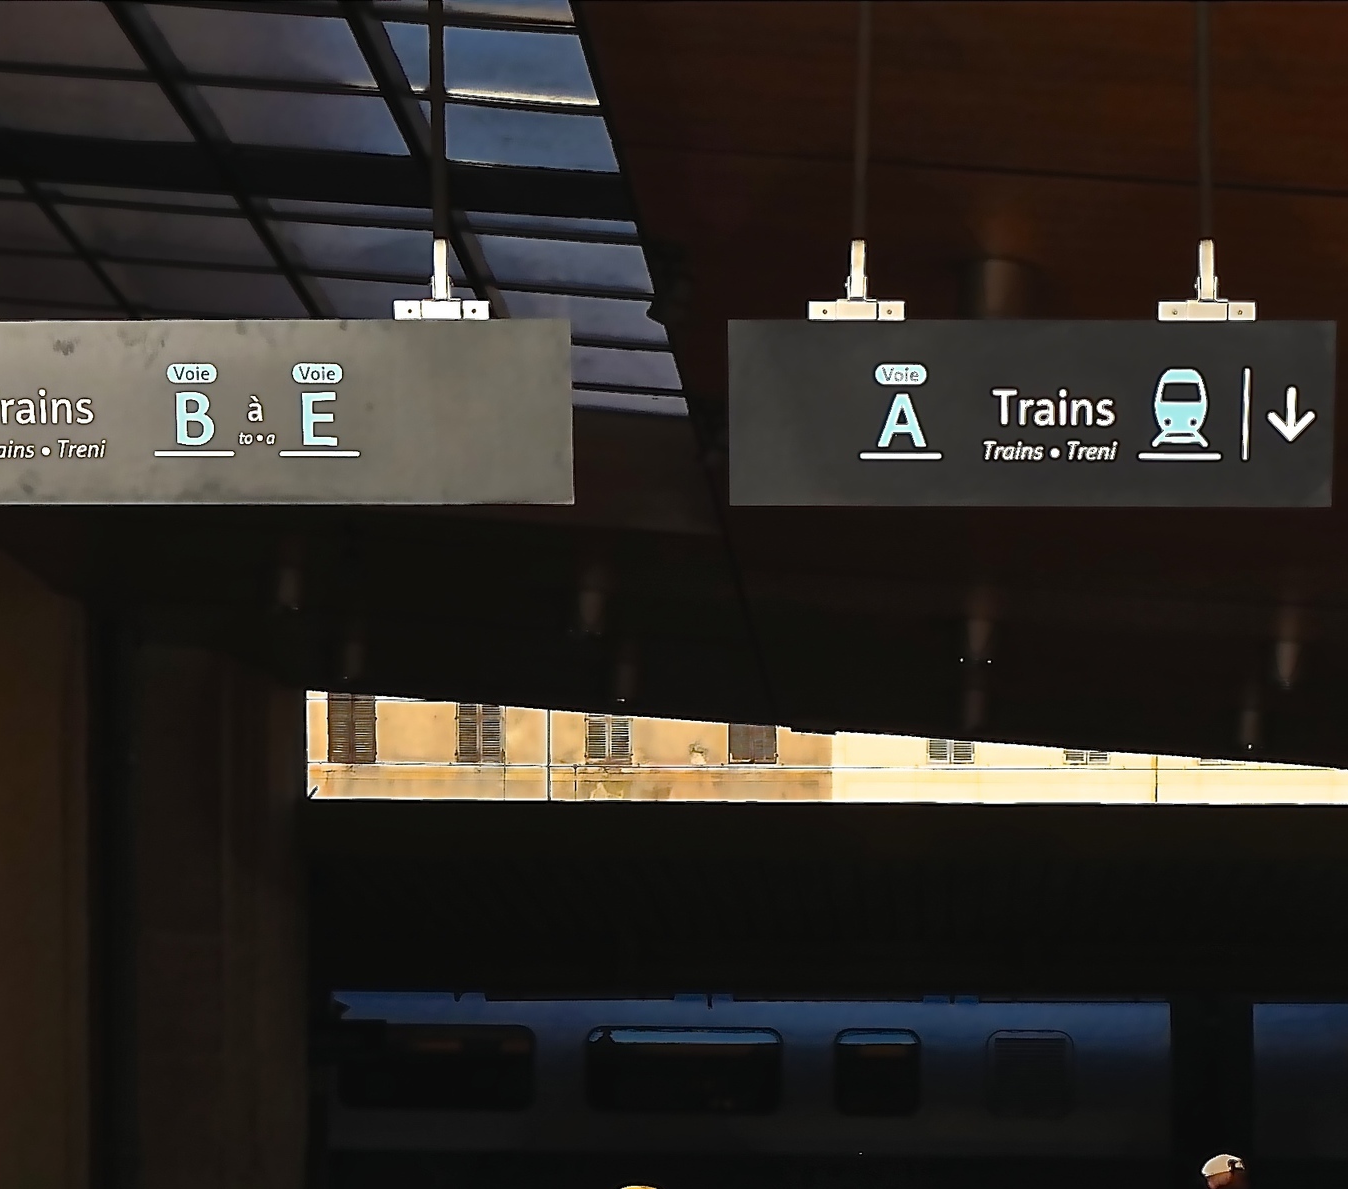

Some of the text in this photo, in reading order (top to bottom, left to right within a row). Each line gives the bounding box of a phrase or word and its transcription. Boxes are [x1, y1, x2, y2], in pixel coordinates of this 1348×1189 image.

[172, 366, 336, 381] Voie Voie
[880, 366, 920, 382] Voie
[991, 388, 1116, 426] Trains
[175, 391, 339, 447] B à E
[877, 393, 927, 448] A
[57, 438, 107, 459] Treni
[982, 440, 1119, 461] Trains Treni
